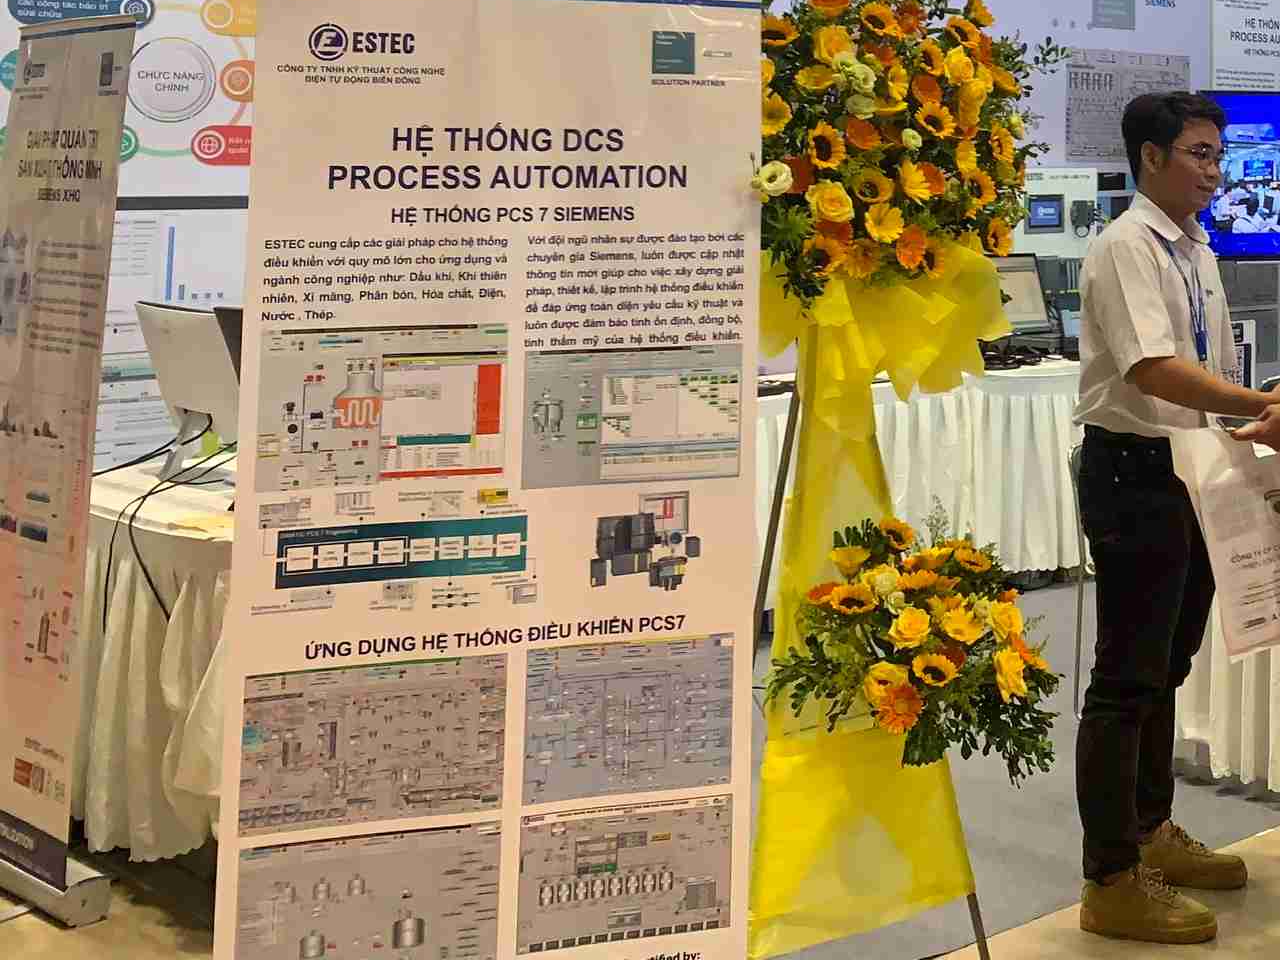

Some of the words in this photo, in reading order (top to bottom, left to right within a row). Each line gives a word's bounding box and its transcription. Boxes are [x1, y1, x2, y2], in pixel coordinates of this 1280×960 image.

[352, 32, 415, 54] ESTEC
[1230, 31, 1268, 43] PROCESS
[391, 125, 435, 159] HỆ
[444, 121, 552, 153] THỐNG
[562, 128, 625, 153] DCS
[327, 164, 481, 191] PROCESS
[489, 164, 688, 190] AUTOMATION
[391, 206, 417, 226] HỆ
[422, 202, 491, 224] THỐNG
[496, 206, 534, 223] PCS
[538, 206, 549, 222] 7
[553, 206, 635, 223] SIEMENS
[264, 240, 305, 249] ESTEC
[308, 240, 337, 252] cung
[340, 236, 359, 250] cấp
[363, 237, 382, 248] các
[385, 237, 405, 250] giải
[408, 238, 435, 249] pháp
[438, 238, 458, 247] cho
[460, 237, 474, 248] hệ
[476, 236, 508, 249] thống
[263, 257, 289, 268] điều
[292, 255, 324, 267] khiển
[326, 256, 345, 266] với
[349, 257, 369, 268] quy
[373, 256, 390, 265] mô
[394, 255, 412, 265] lớn
[415, 255, 436, 265] cho
[464, 254, 492, 266] dụng
[495, 254, 507, 264] và
[263, 274, 300, 287] ngành
[304, 274, 332, 287] công
[336, 273, 375, 285] nghiệp
[409, 270, 432, 282] Dầu
[458, 270, 476, 281] Khí
[480, 271, 507, 281] thiên
[305, 640, 352, 660] ỨNG
[358, 636, 416, 658] DỤNG
[422, 634, 448, 652] HỆ
[454, 627, 523, 650] THỐNG
[527, 621, 572, 642] ĐIỀU
[577, 616, 633, 637] KHIỂN
[638, 614, 687, 632] PCS7
